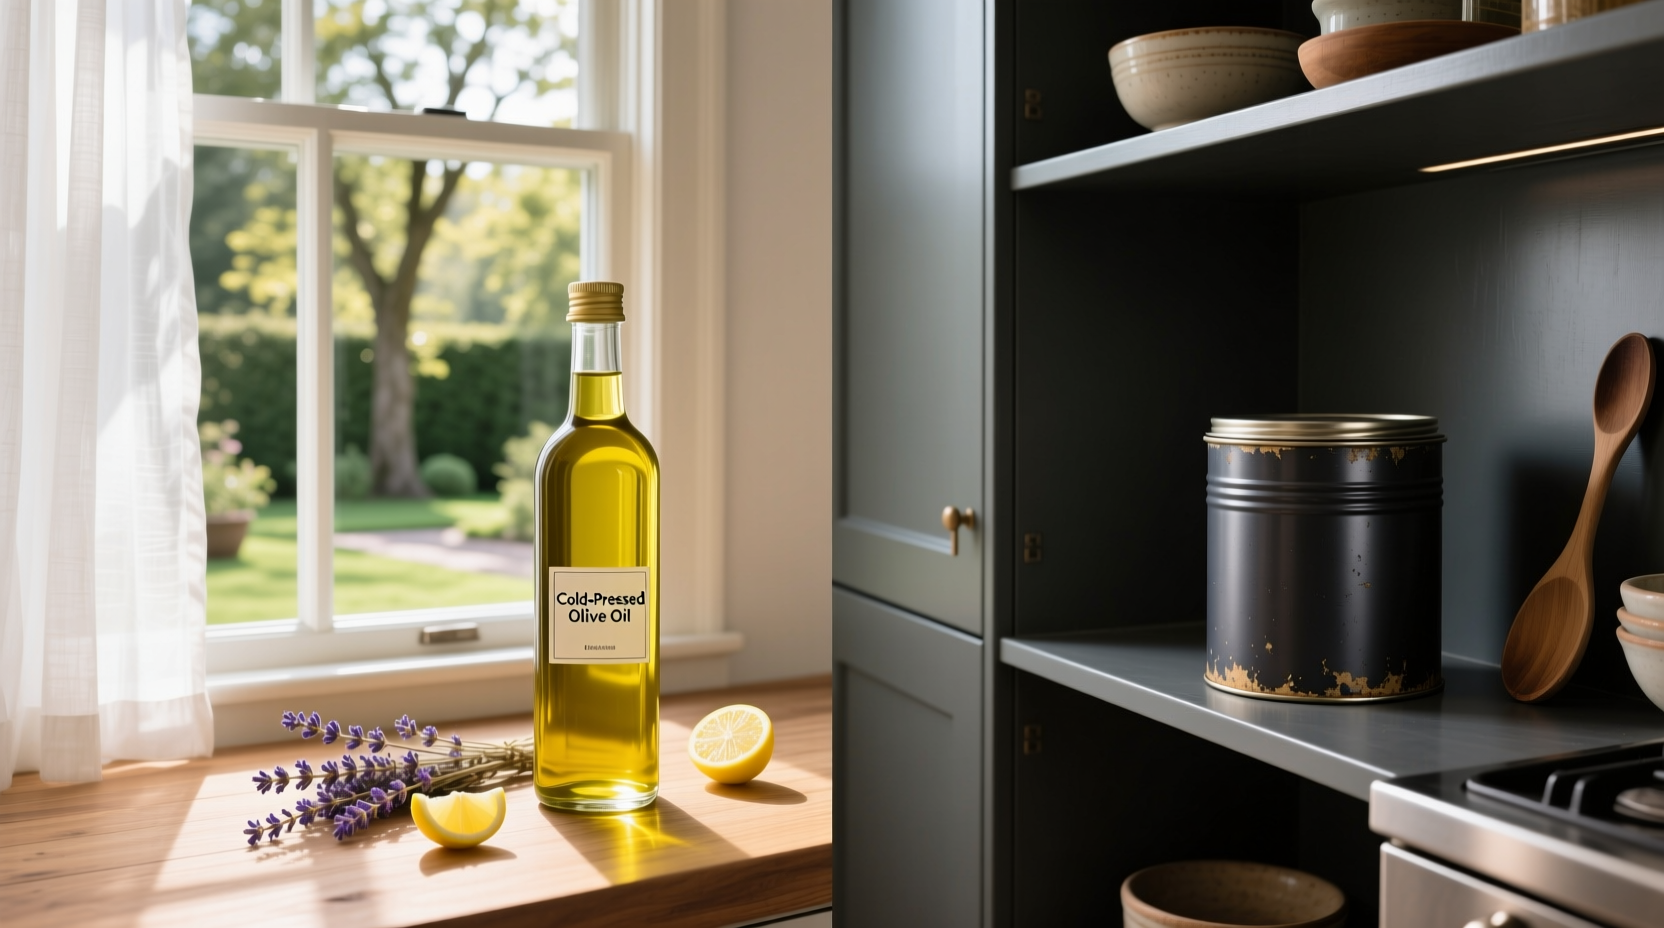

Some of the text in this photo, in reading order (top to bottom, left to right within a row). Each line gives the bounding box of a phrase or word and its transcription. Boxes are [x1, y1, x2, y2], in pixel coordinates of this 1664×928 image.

[556, 591, 646, 606] Cold-Pressed
[568, 608, 631, 623] Olive Oil
